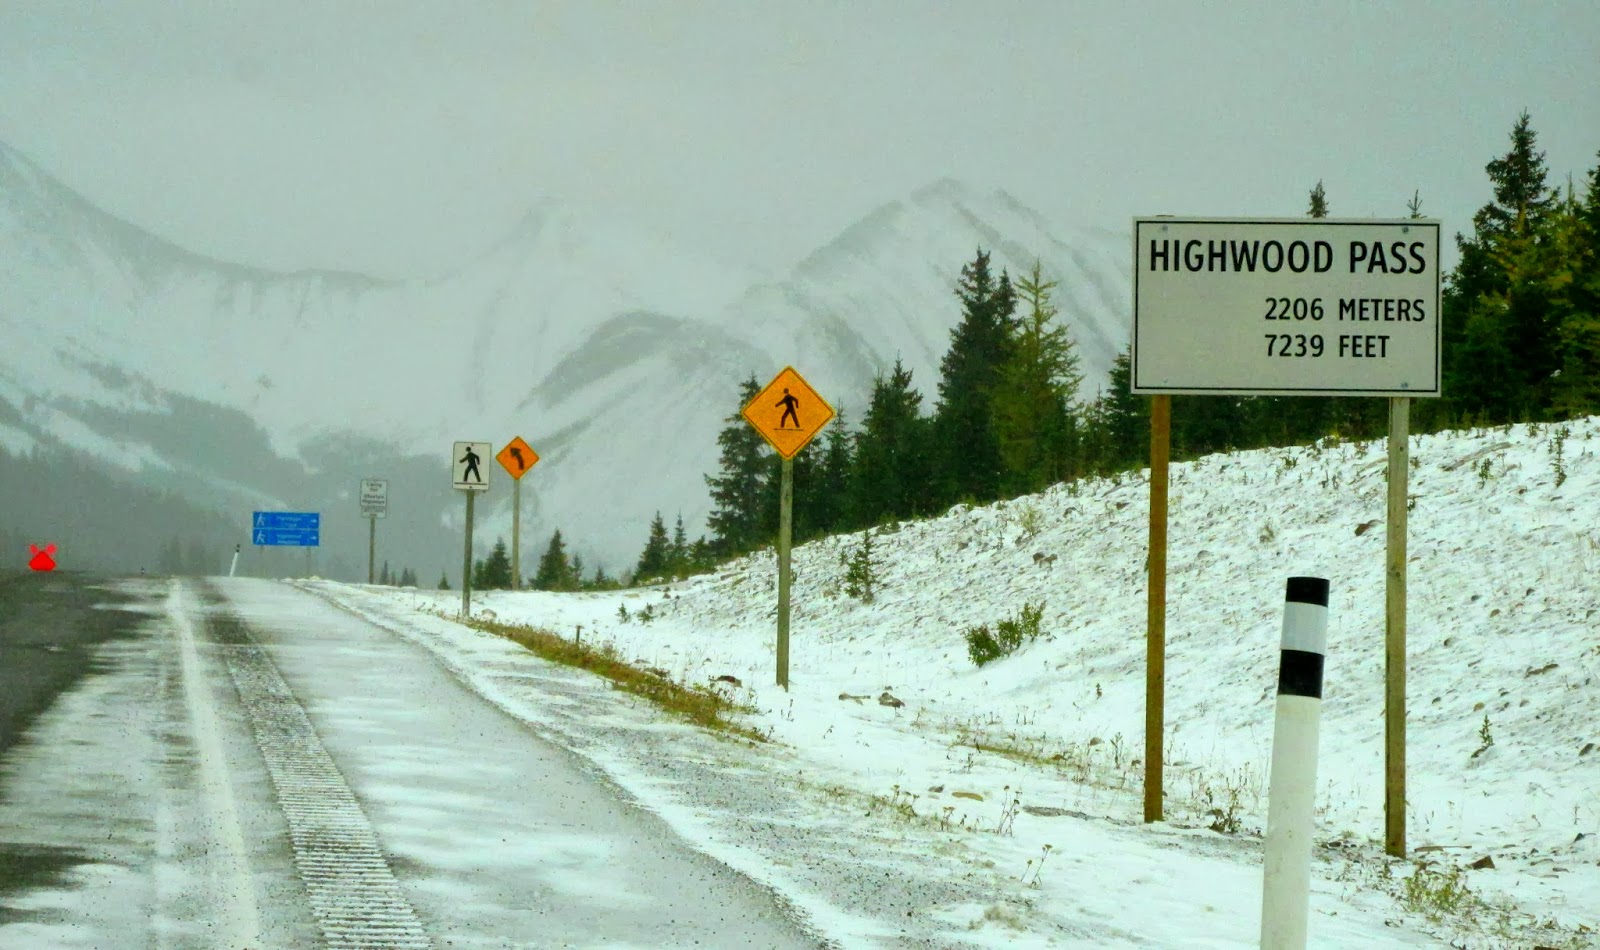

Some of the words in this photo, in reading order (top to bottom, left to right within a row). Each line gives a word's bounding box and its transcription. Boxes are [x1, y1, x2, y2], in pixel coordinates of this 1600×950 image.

[1151, 240, 1333, 273] HIGHWOOD
[1350, 241, 1426, 274] PASS
[1265, 298, 1324, 321] 2206
[1339, 299, 1425, 322] METERS
[1265, 334, 1324, 357] 7239
[1339, 335, 1390, 357] FEET
